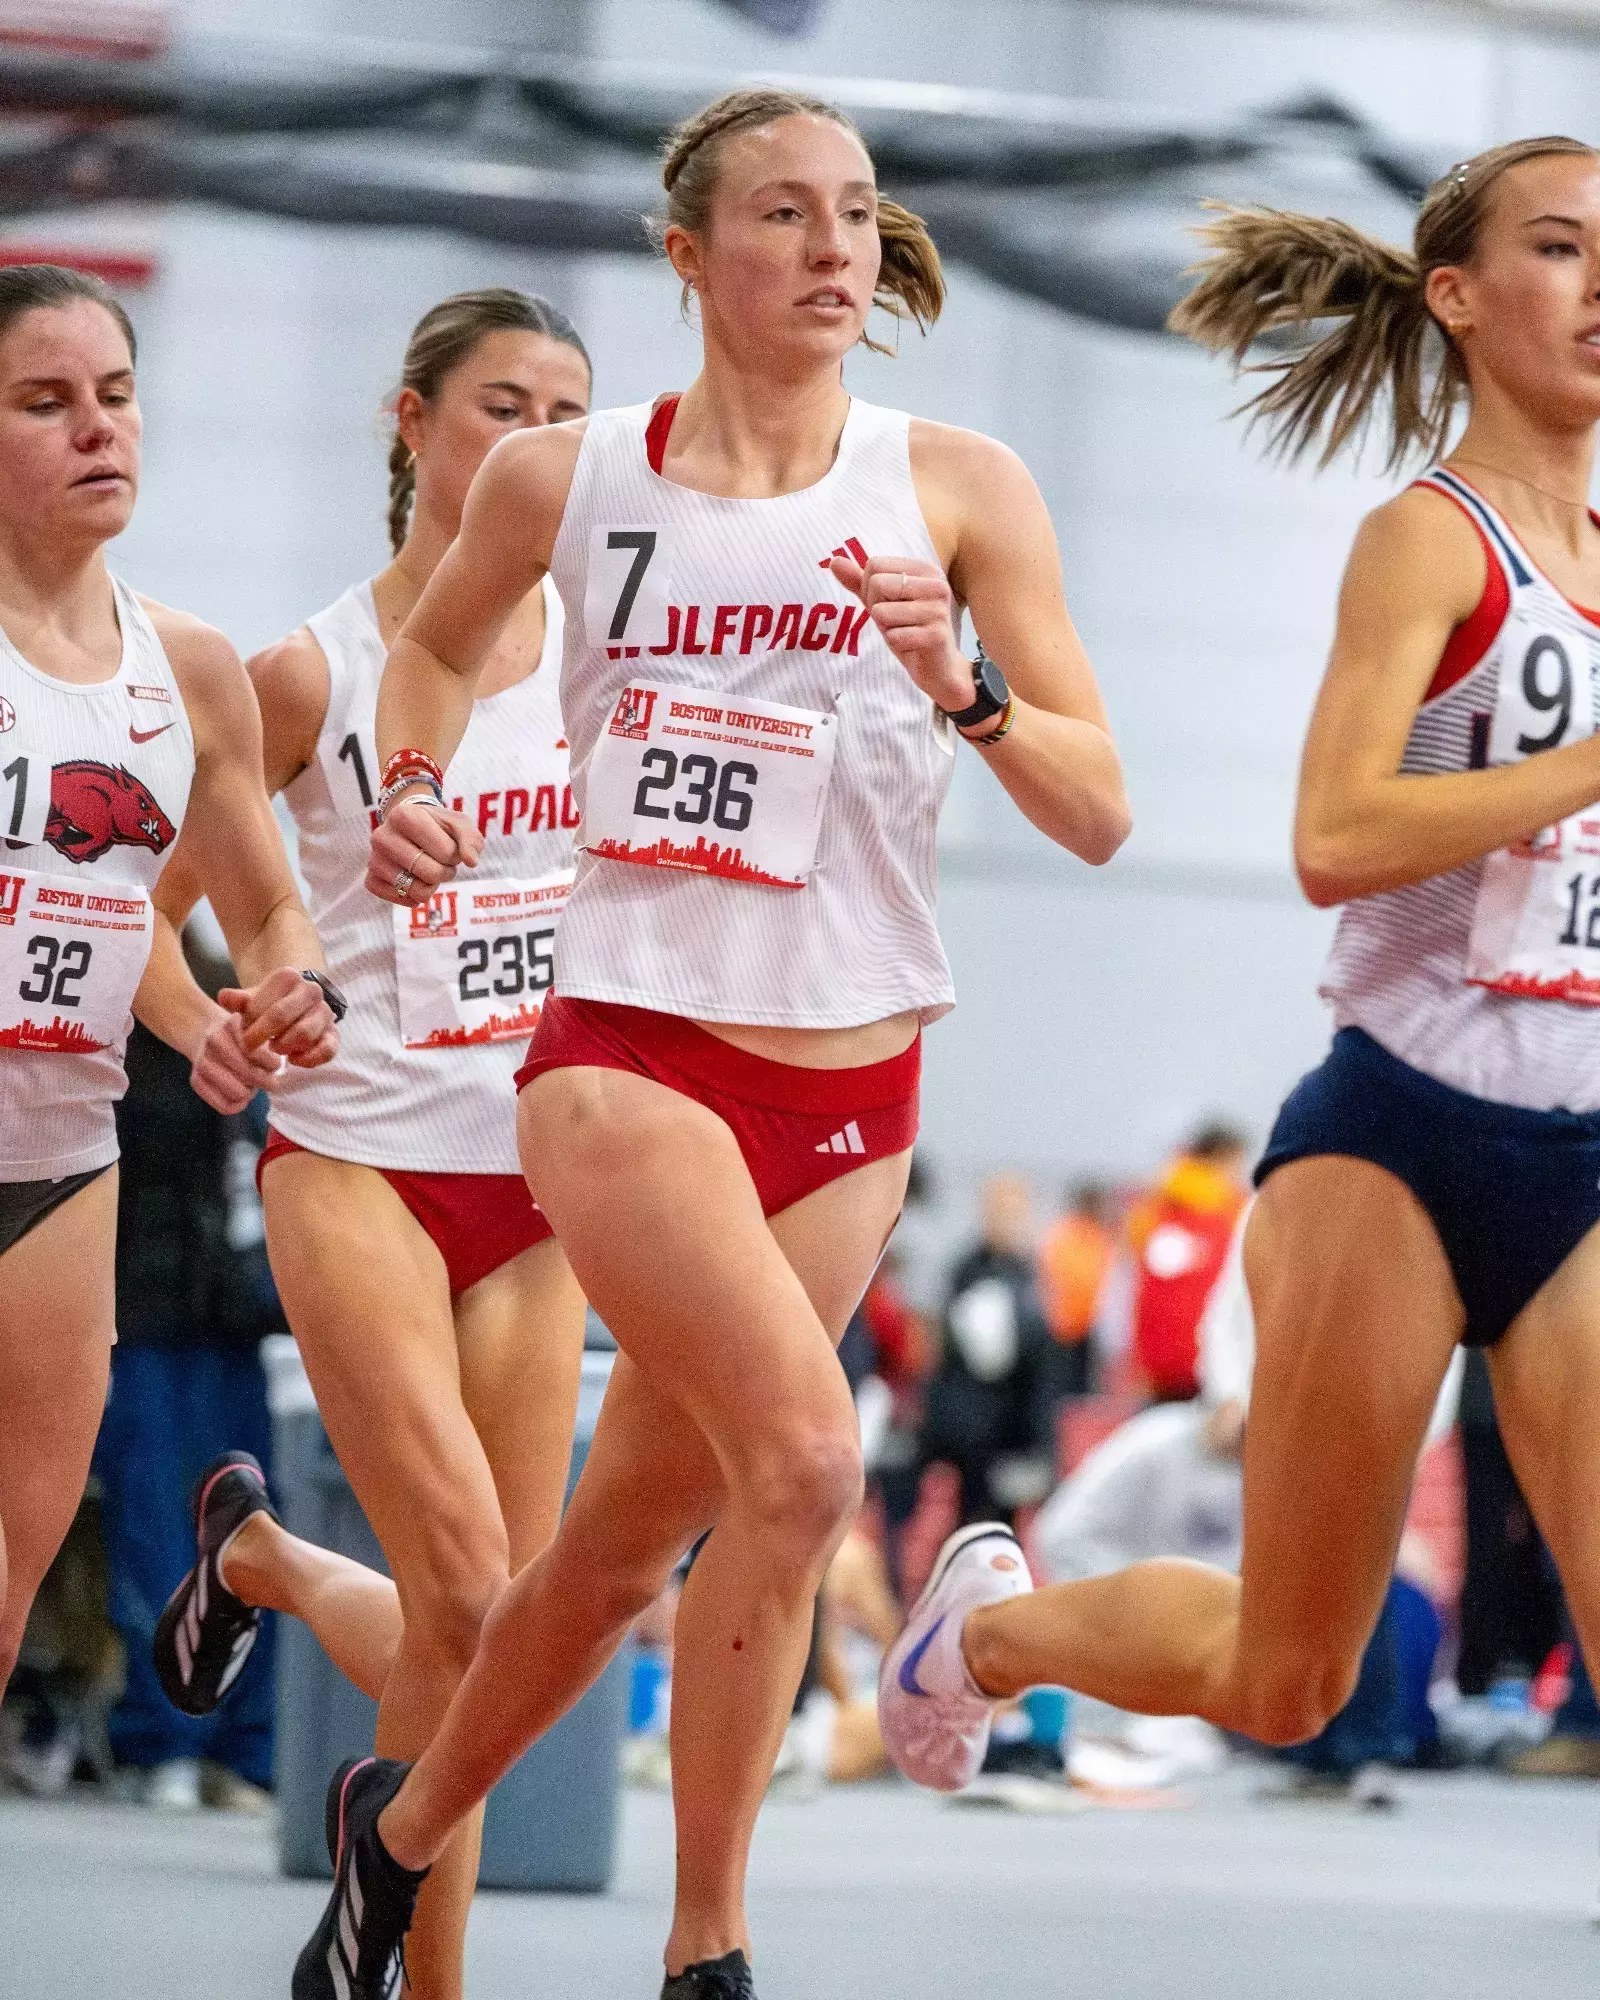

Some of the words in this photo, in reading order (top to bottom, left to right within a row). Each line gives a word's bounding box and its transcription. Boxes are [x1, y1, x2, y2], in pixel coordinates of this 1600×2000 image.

[606, 531, 657, 640] 7
[606, 603, 870, 660] LFPACK
[611, 687, 658, 731] BU
[669, 702, 723, 724] BOSTON
[726, 710, 813, 739] UNIVERSITY
[1516, 634, 1572, 753] 9
[3, 756, 29, 836] 1
[338, 732, 374, 807] 1
[633, 747, 758, 832] 236
[36, 888, 84, 908] BOSTON
[87, 895, 146, 915] UNIVERSITY
[473, 892, 520, 908] BOSTON
[19, 935, 92, 1007] 32
[458, 928, 555, 1001] 235
